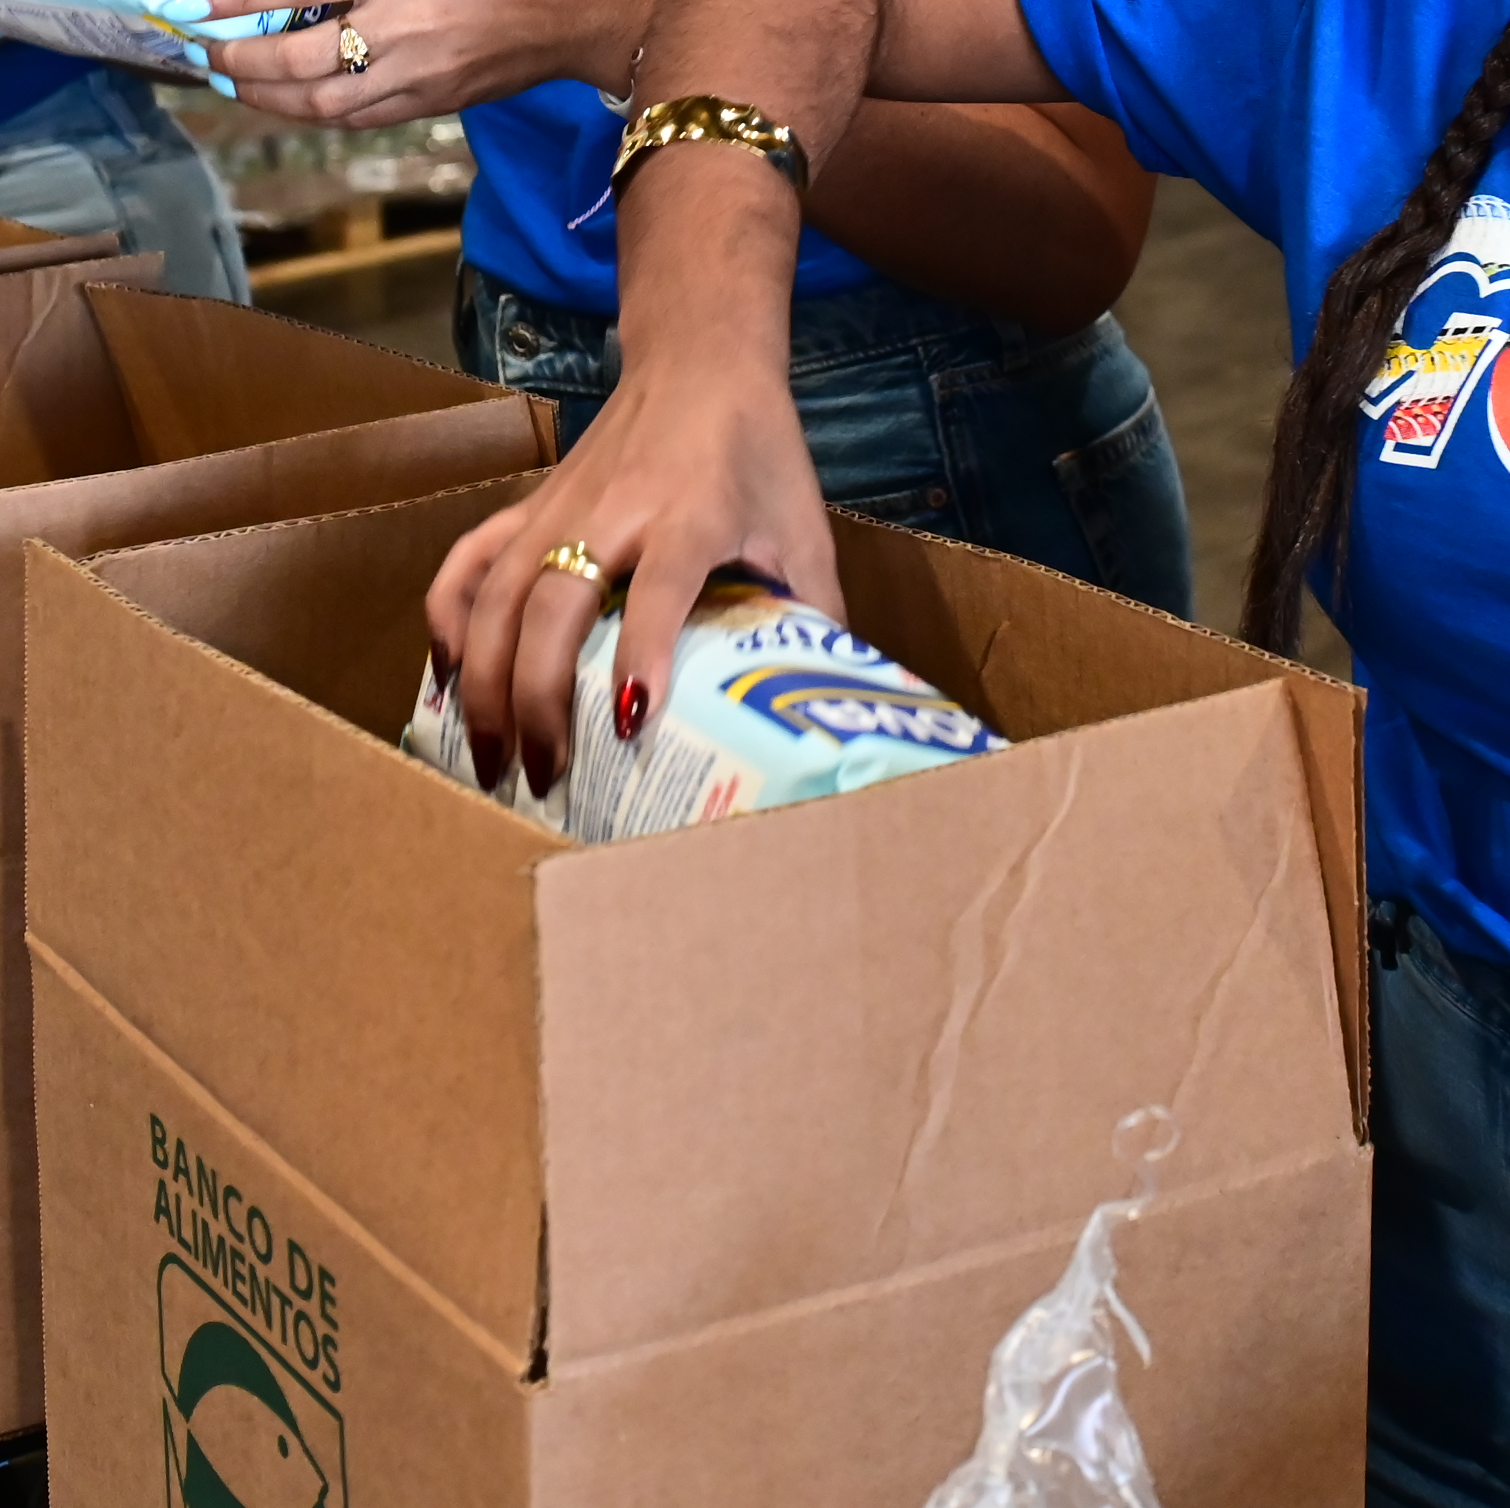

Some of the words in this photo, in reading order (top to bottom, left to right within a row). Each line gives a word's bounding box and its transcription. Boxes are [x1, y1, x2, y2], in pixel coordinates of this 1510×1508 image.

[149, 1113, 274, 1267] BANCO
[286, 1232, 337, 1331] DE
[153, 1180, 343, 1395] ALIMENTOS
